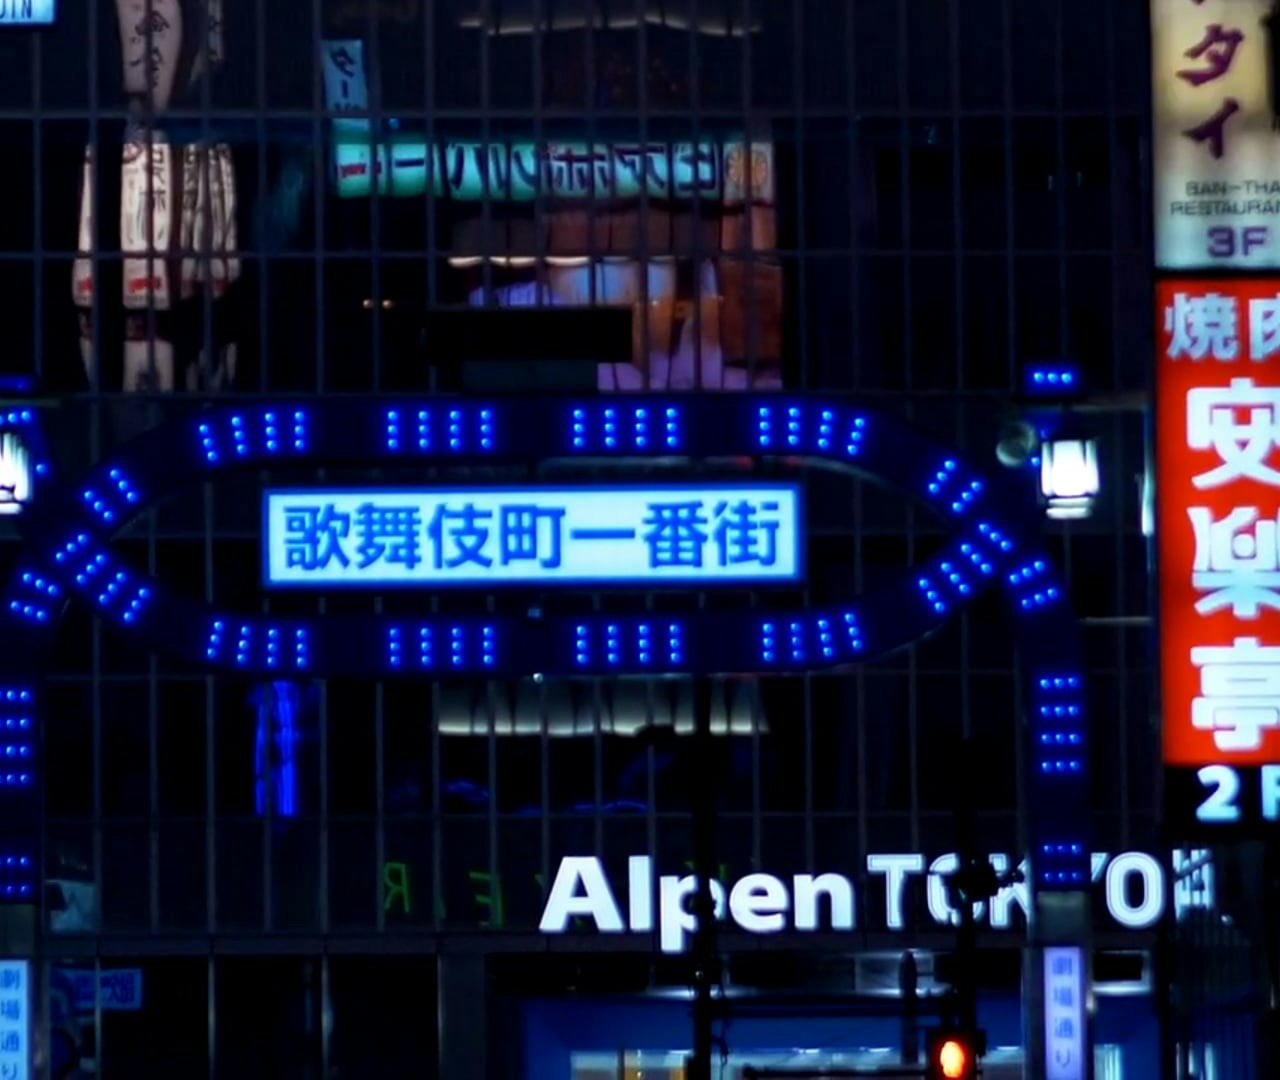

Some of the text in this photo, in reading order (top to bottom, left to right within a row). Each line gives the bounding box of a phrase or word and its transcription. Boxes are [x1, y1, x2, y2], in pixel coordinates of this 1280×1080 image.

[1206, 225, 1268, 259] 3F
[282, 502, 781, 571] 歌舞伎町一番街
[537, 855, 856, 953] Alpen
[866, 850, 1167, 929] TOKO
